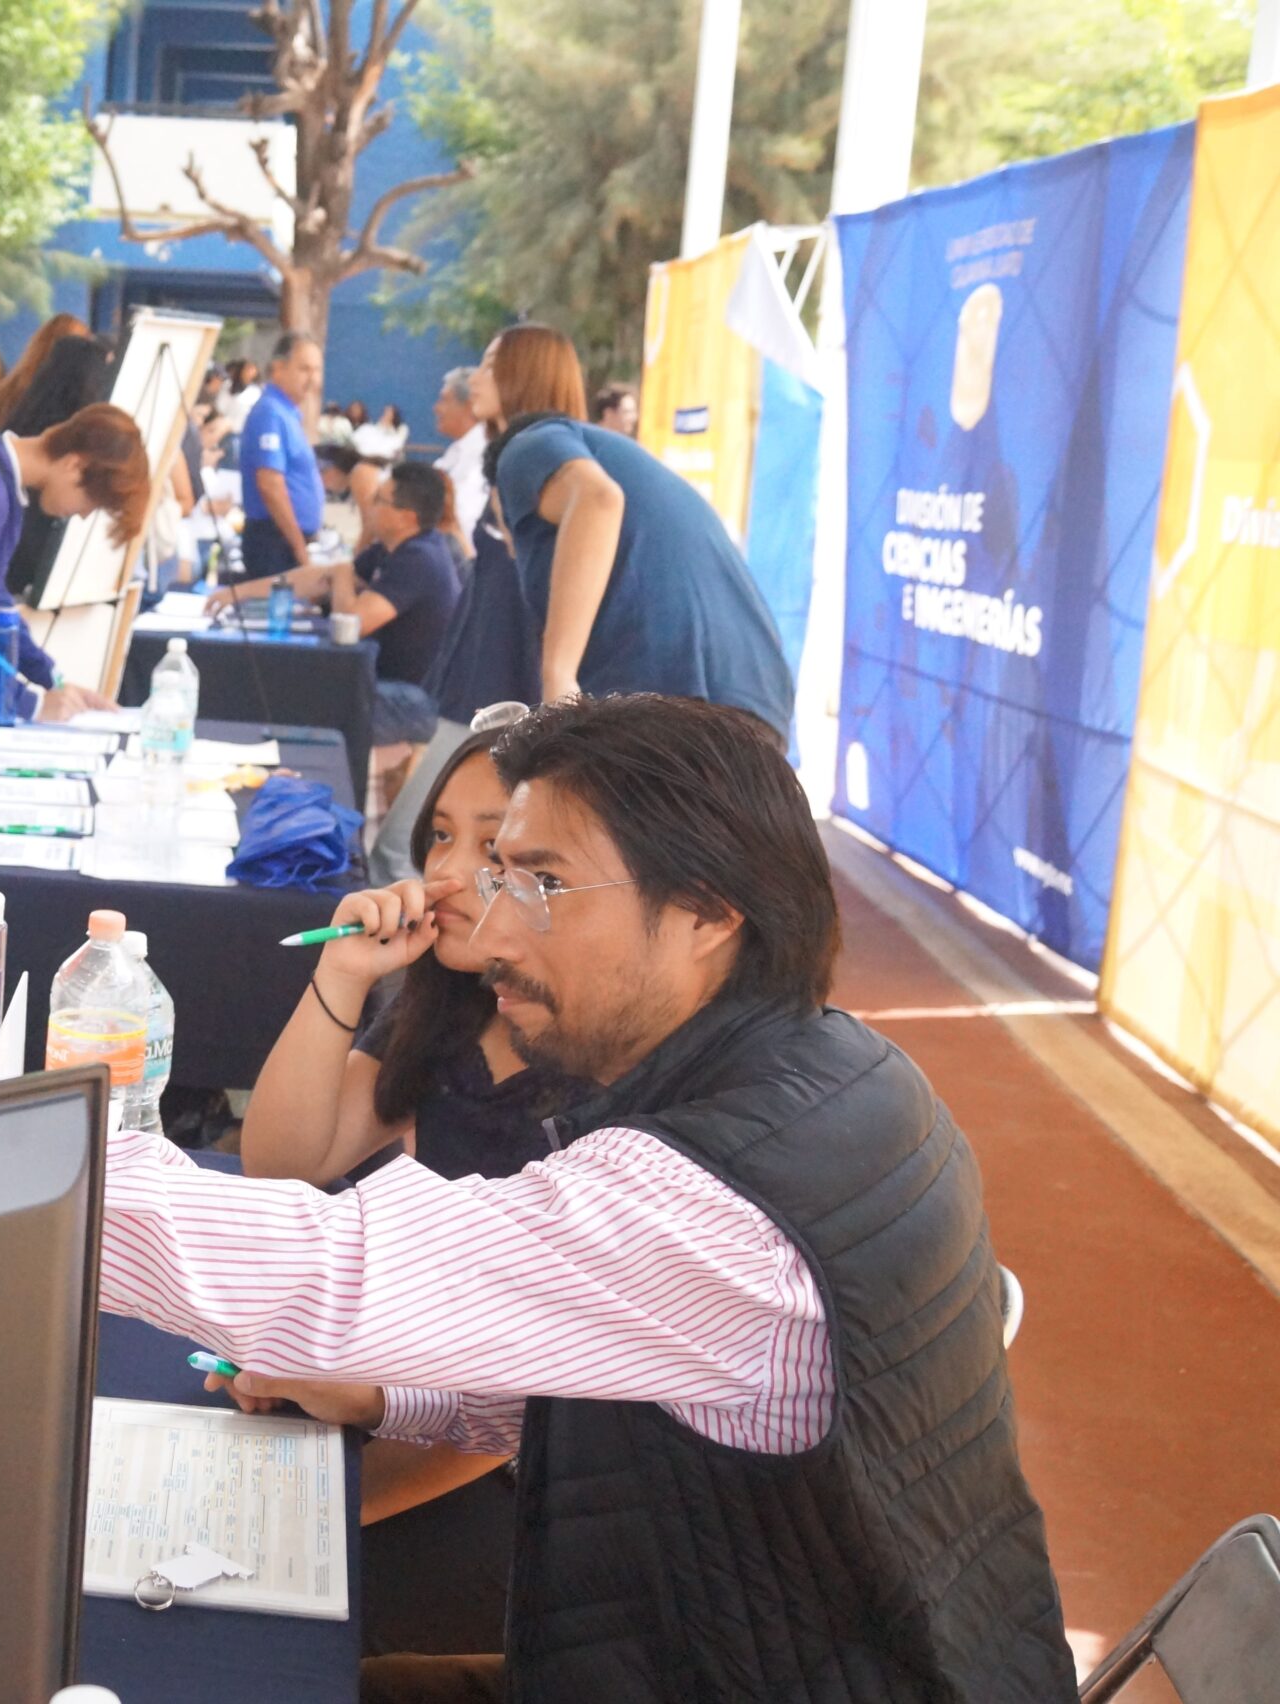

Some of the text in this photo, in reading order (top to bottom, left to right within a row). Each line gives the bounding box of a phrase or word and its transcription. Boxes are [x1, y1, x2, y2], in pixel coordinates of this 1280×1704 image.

[896, 484, 985, 532] DIVISIÓN DE
[882, 530, 967, 586] CIENCIAS
[902, 583, 1043, 657] E INGENIERÍAS
